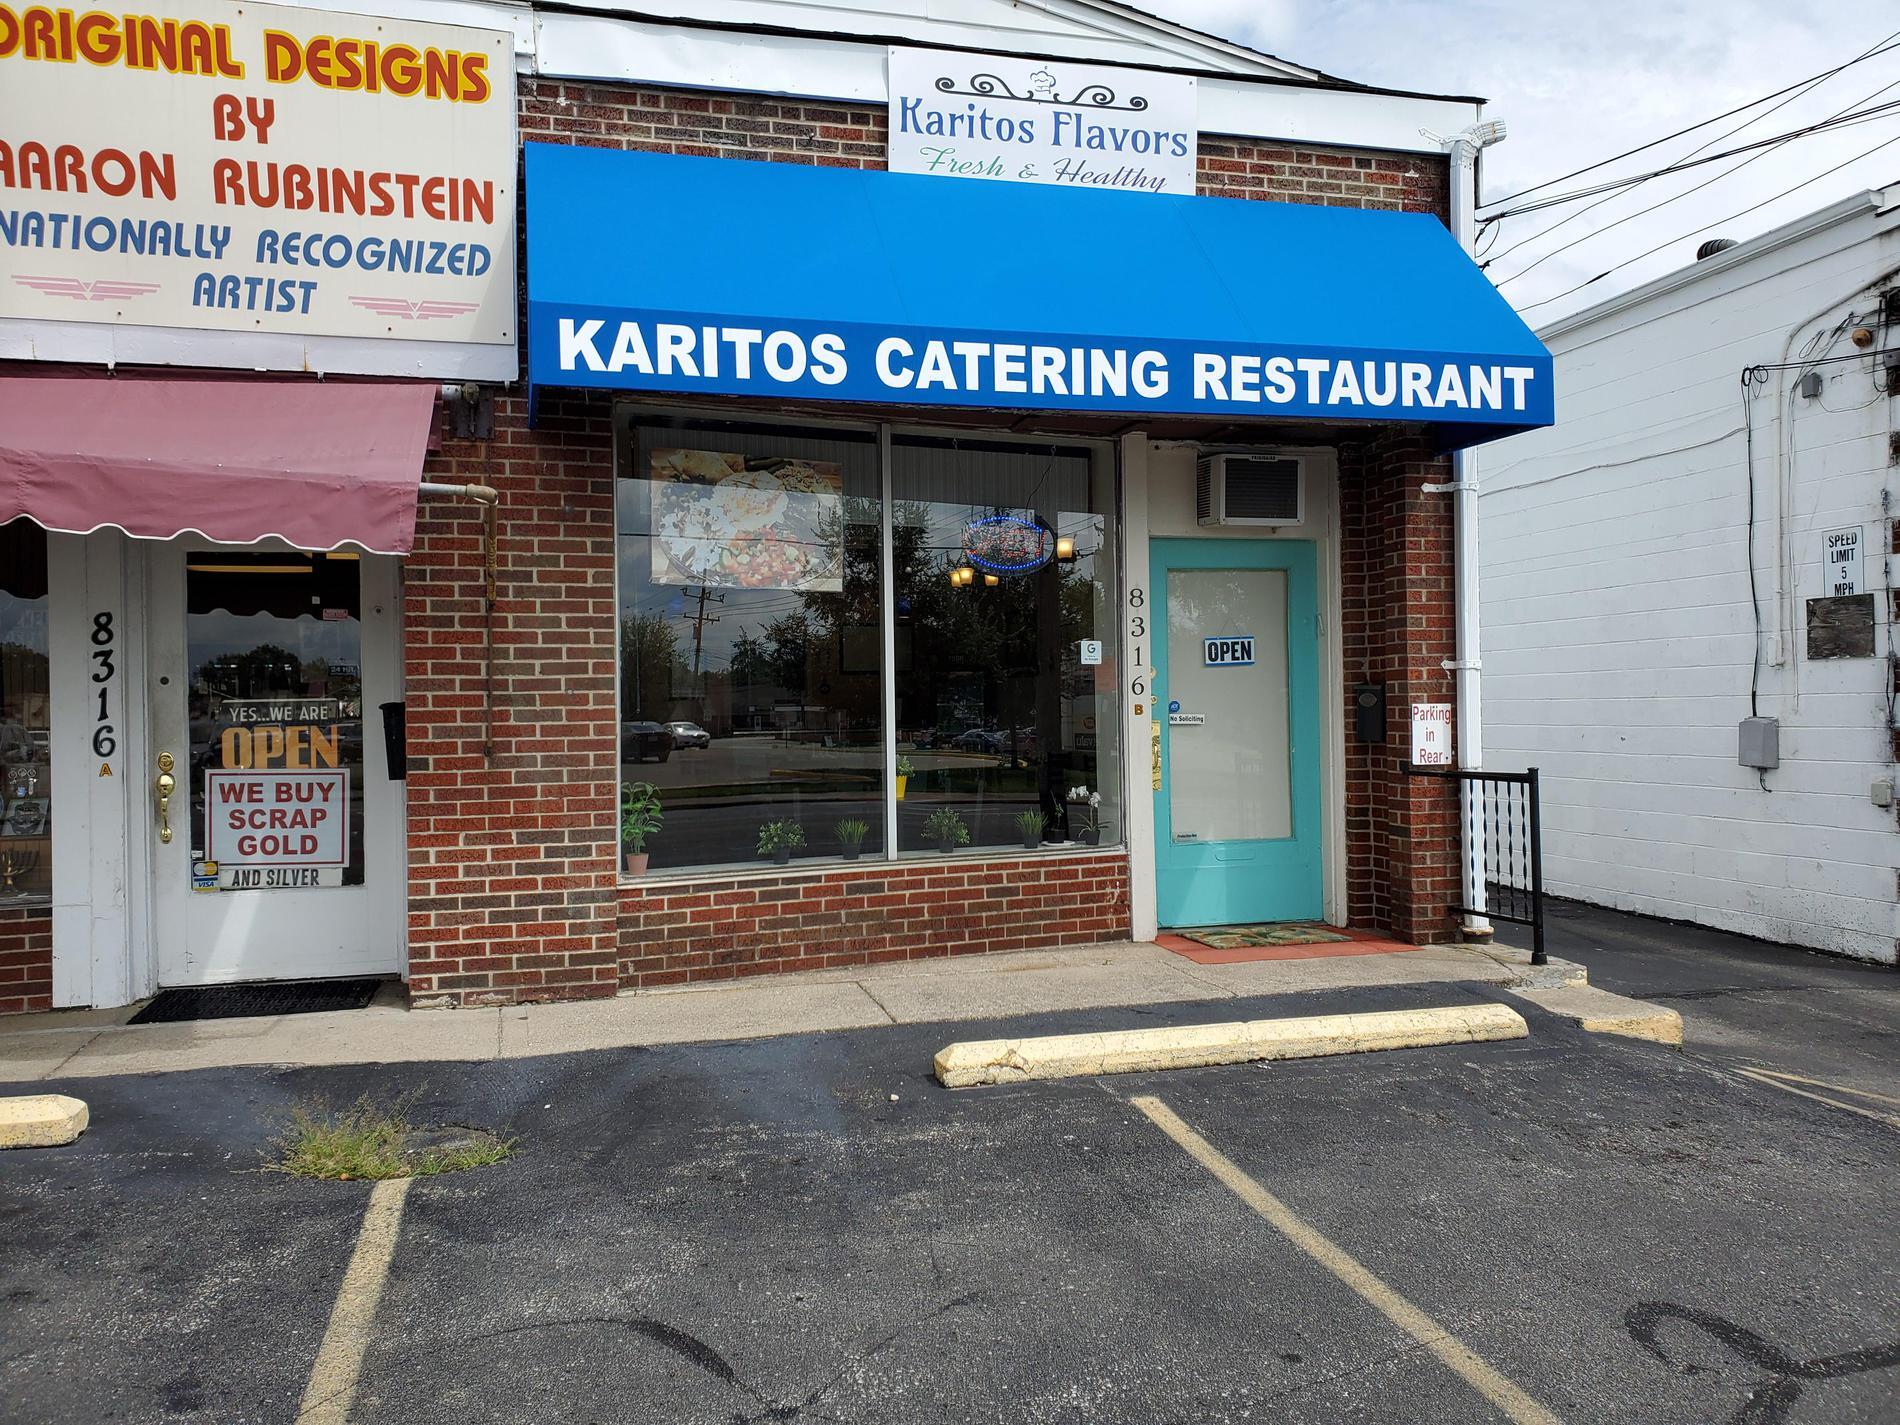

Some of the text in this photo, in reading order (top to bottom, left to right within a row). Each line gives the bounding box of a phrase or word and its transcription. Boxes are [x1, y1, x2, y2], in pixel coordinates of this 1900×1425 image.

[264, 29, 492, 104] DESIGNS
[213, 93, 275, 145] BY
[900, 96, 1188, 157] Karitos Flavors
[919, 146, 1167, 193] Fresh & Healthy
[213, 158, 494, 225] RUBINSTEIN
[0, 209, 492, 277] NATIONALLY RECOGNIZED
[193, 272, 318, 315] ARTIST
[559, 318, 1534, 411] KARITOS CATERING RESTAURANT
[1828, 532, 1857, 548] SPEED
[1831, 548, 1855, 564] LIMIT
[1841, 566, 1847, 579] 5
[1834, 582, 1854, 597] MPH
[1129, 588, 1145, 696] 8316
[1208, 640, 1252, 662] OPEN
[91, 611, 116, 757] 8316
[300, 706, 328, 720] ARE
[1134, 704, 1144, 715] B
[1179, 715, 1204, 723] Soliciting
[1413, 705, 1450, 725] Parking
[1425, 727, 1435, 742] in
[221, 724, 338, 769] OPEN
[1419, 748, 1443, 763] Rear
[99, 763, 113, 777] A
[219, 782, 336, 803] WE BUY
[228, 808, 327, 829] SCRAP
[238, 834, 318, 856] GOLD
[232, 868, 320, 886] AND SILVER
